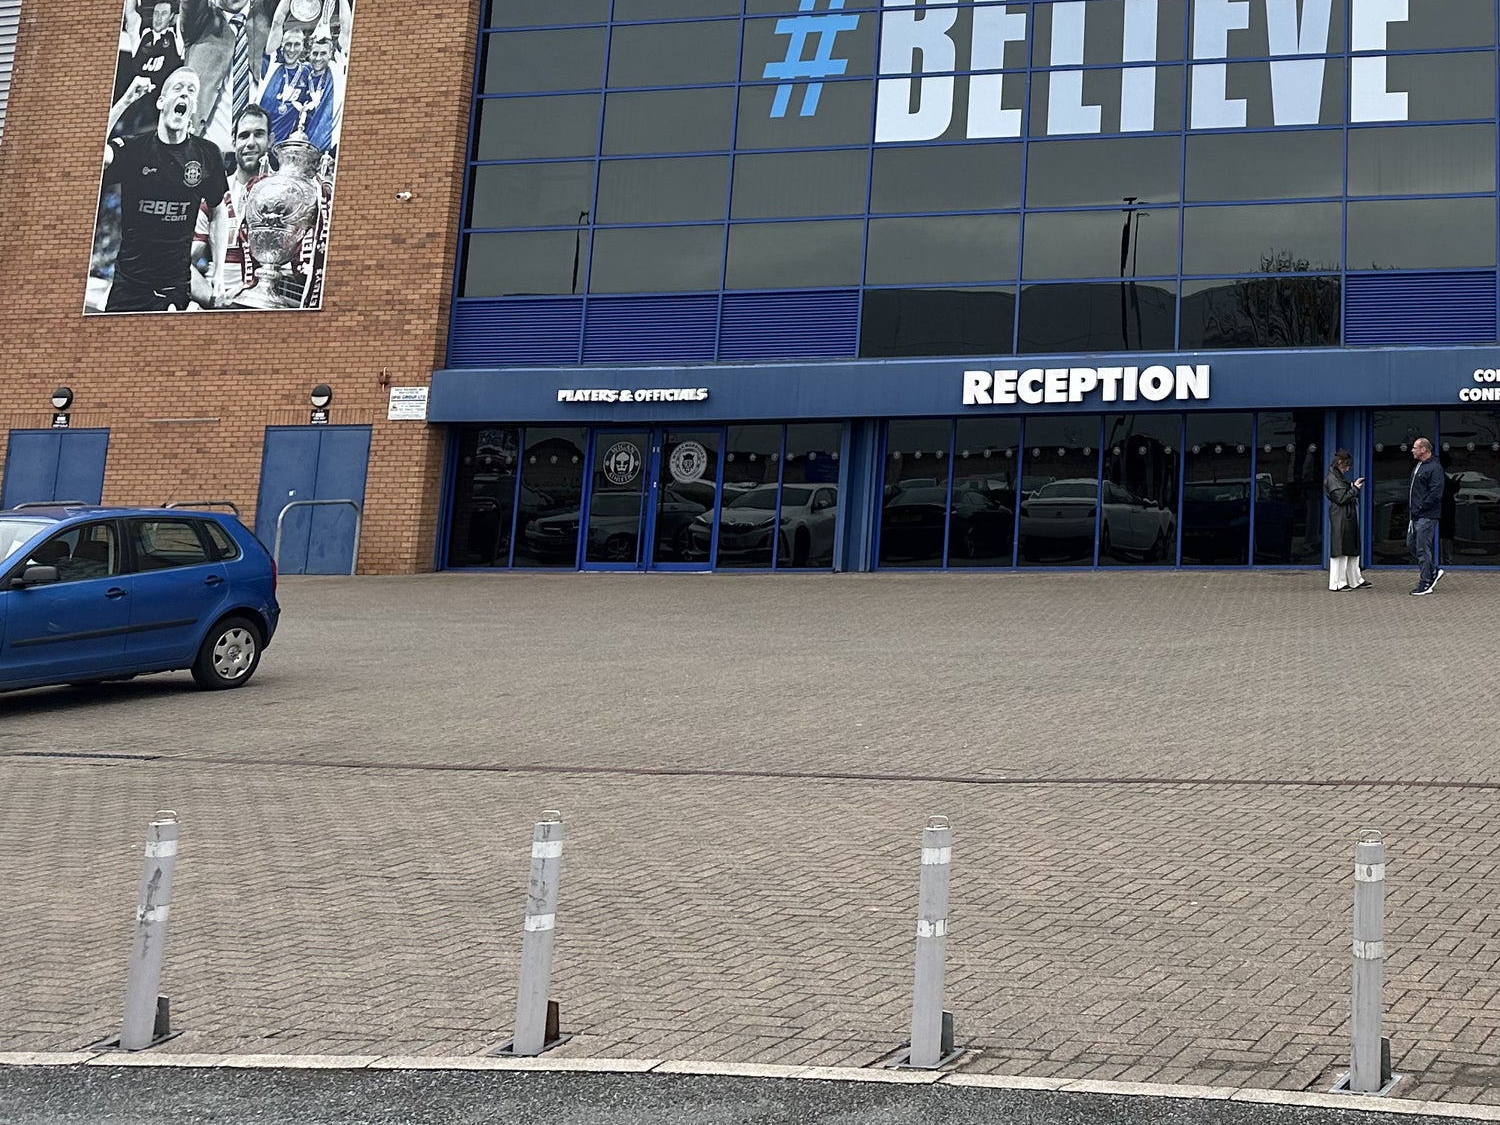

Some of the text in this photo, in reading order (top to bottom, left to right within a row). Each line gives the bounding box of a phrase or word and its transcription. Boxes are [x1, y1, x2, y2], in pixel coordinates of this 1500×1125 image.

[142, 56, 165, 72] JJB
[138, 199, 191, 215] 12BET
[962, 365, 1210, 405] RECEPTION
[557, 388, 708, 402] PLAYERS & OFFICIALS
